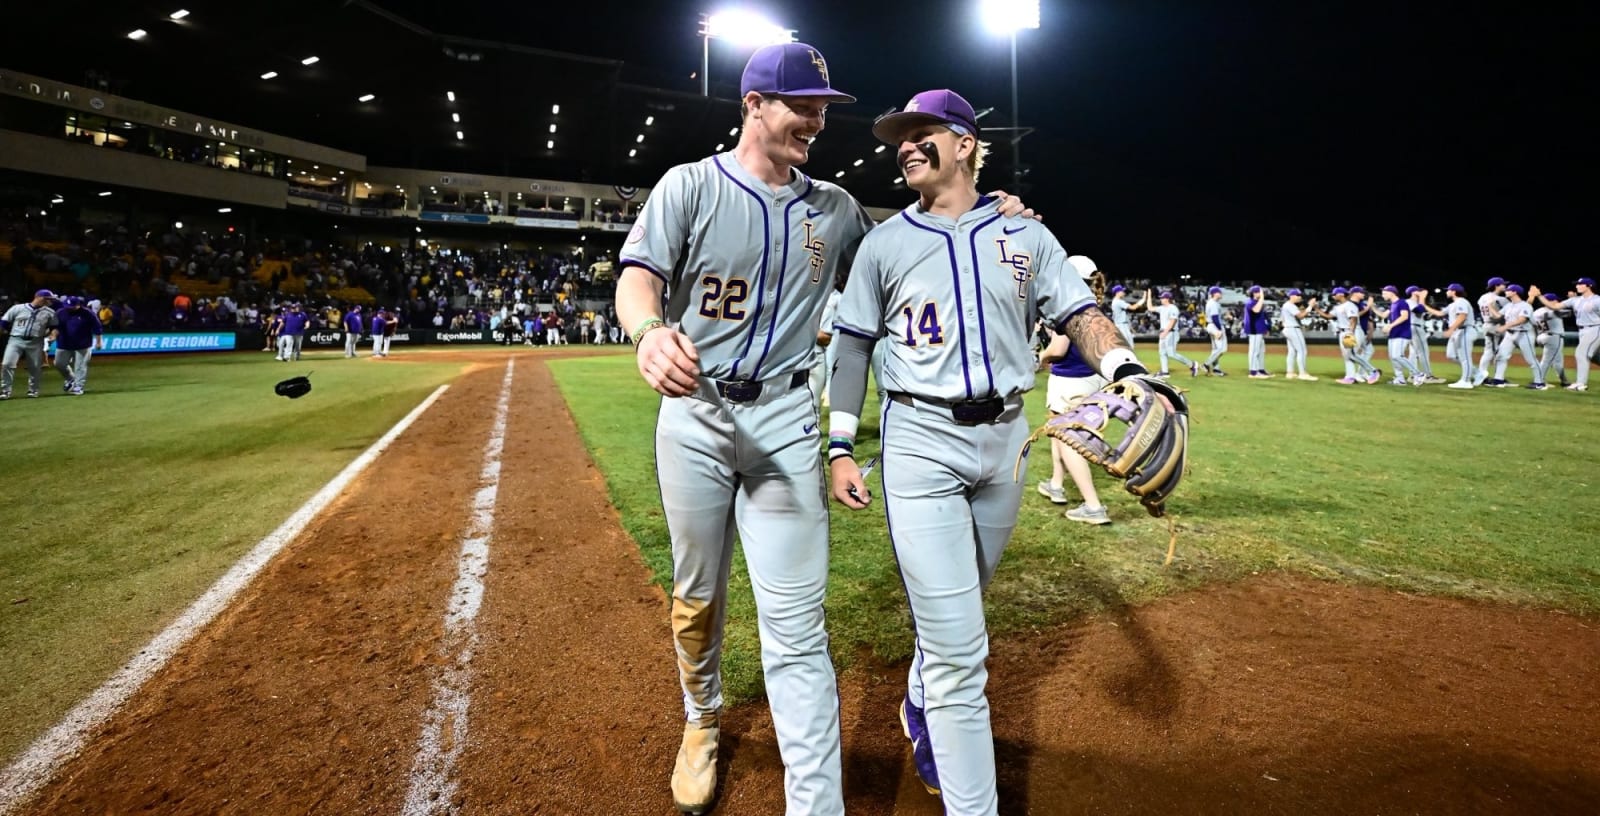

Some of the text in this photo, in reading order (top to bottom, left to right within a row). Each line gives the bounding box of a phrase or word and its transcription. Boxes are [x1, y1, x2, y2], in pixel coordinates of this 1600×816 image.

[803, 221, 825, 284] LSU
[995, 238, 1032, 300] LSU
[698, 275, 748, 321] 22
[111, 337, 158, 349] ROUGE
[160, 335, 220, 348] REGIONAL
[310, 332, 333, 342] efcu
[436, 331, 482, 342] ExxonMobil
[902, 301, 944, 347] 14
